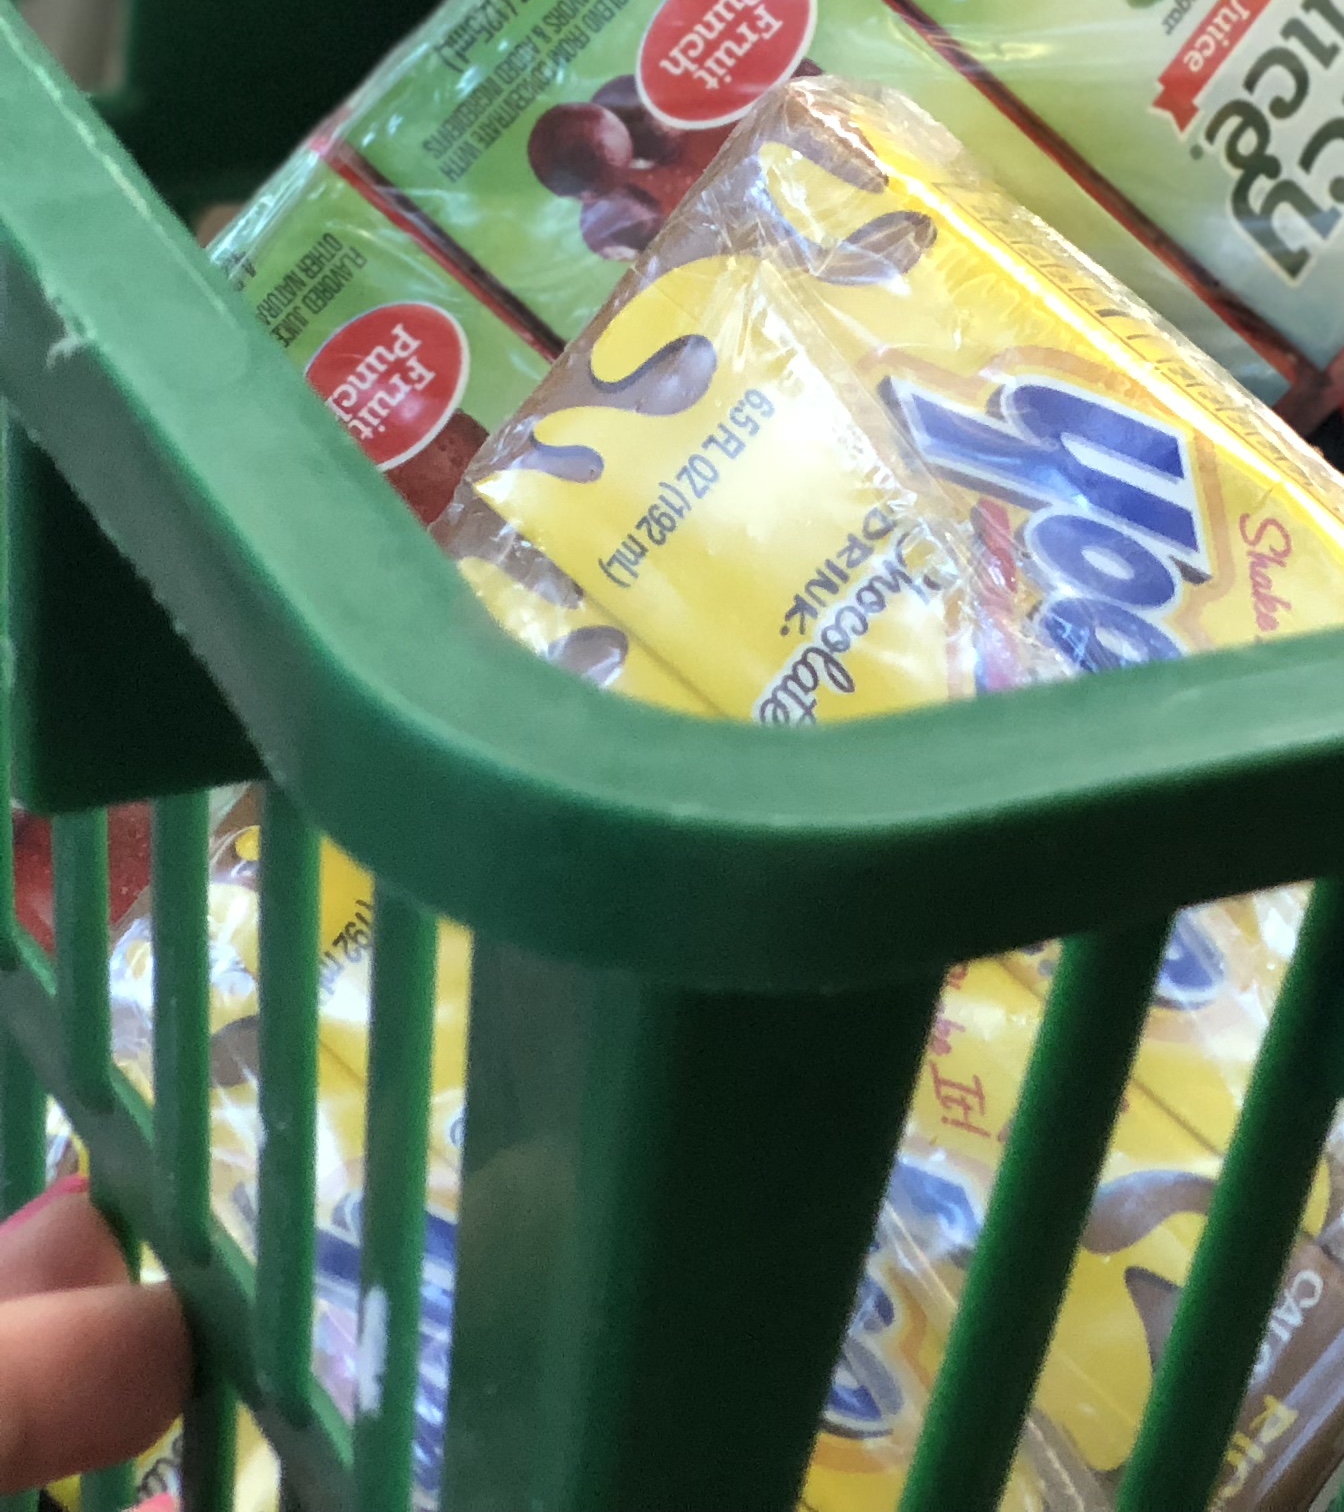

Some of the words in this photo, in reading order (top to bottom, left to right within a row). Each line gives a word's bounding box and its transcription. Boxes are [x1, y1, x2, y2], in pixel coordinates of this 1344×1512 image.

[490, 35, 545, 86] ADDED
[531, 25, 553, 43] &
[545, 23, 593, 68] FROM
[704, 4, 785, 90] Fruit
[418, 75, 506, 160] INGREDIENTS
[468, 59, 560, 148] CONCENTRATE
[436, 139, 483, 183] WITH
[294, 229, 345, 280] OTHER
[298, 243, 370, 317] FLAVORED
[250, 269, 308, 327] NATURA
[268, 303, 314, 348] JUICE
[348, 355, 437, 440] Fruit
[725, 383, 778, 438] 6.5
[672, 448, 724, 501] OZ
[633, 484, 692, 548] (192
[597, 532, 650, 588] mL)
[1239, 511, 1295, 635] Shake
